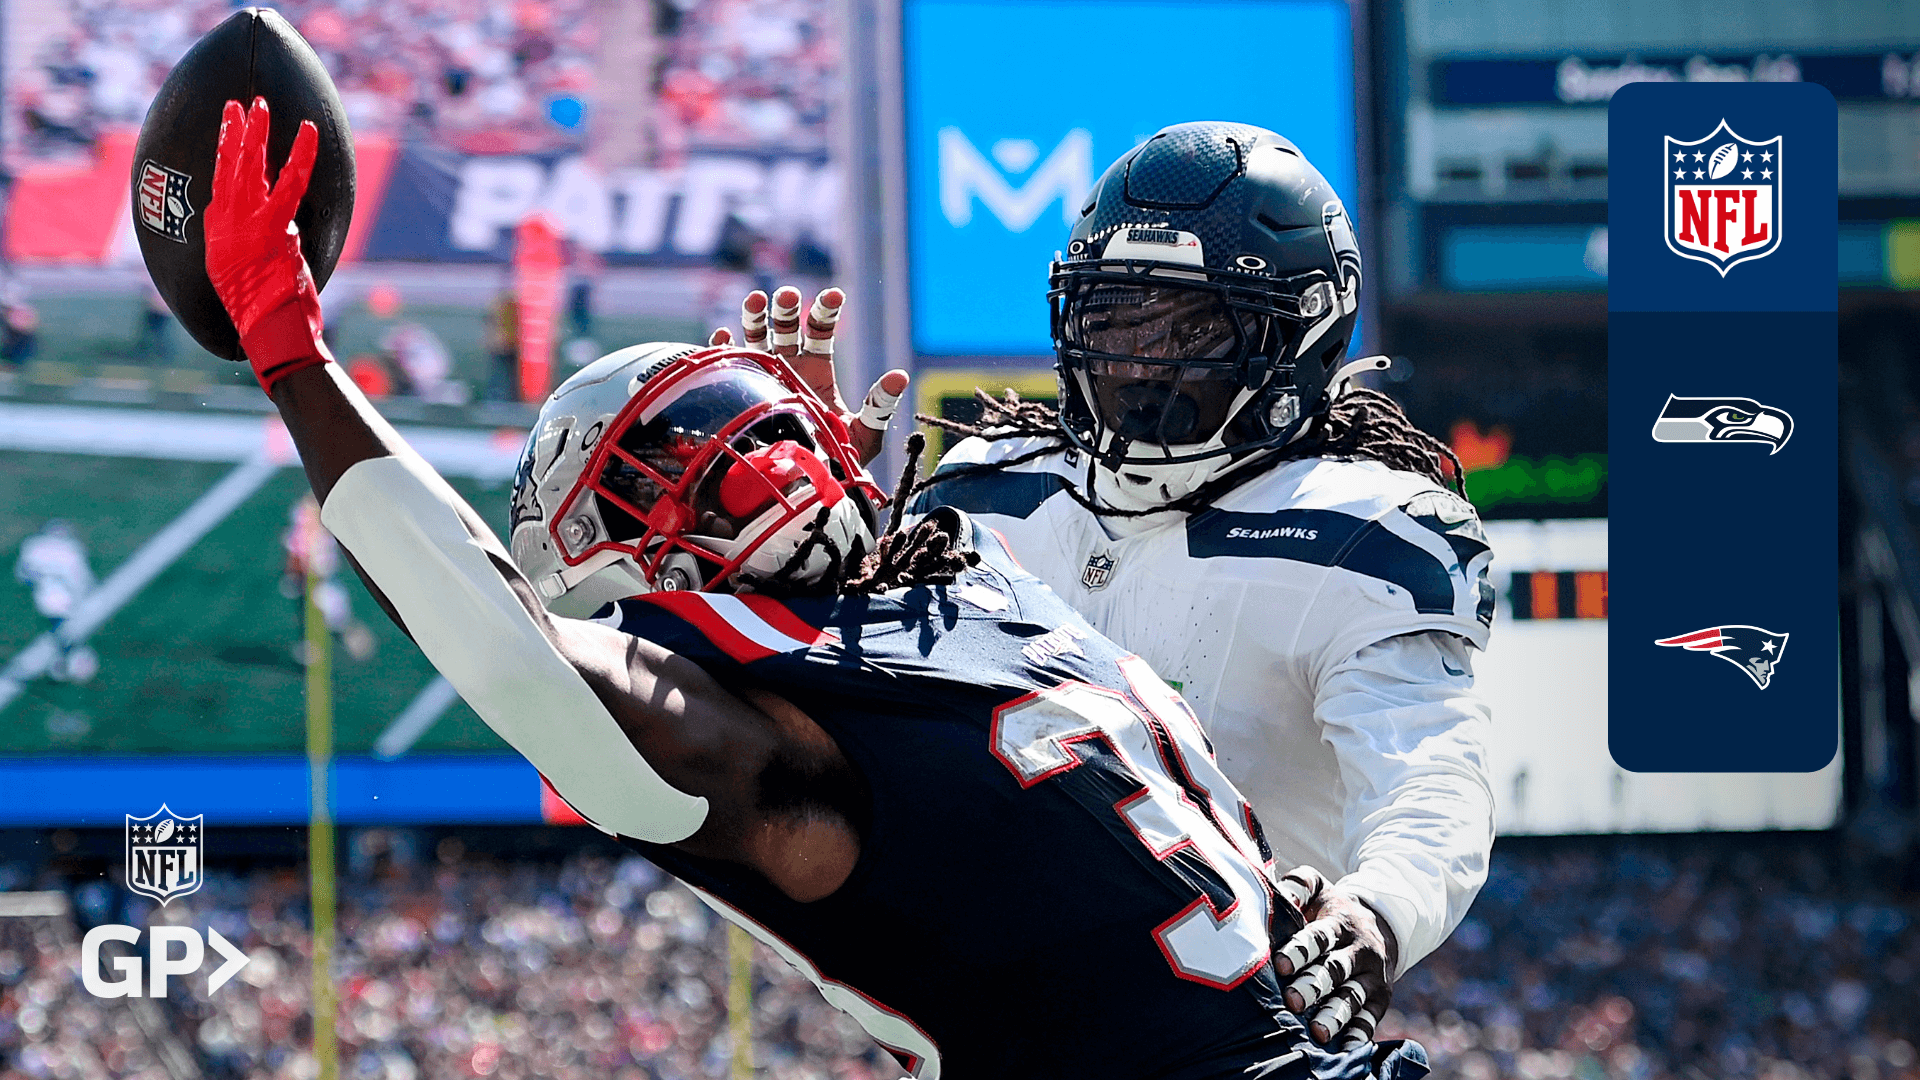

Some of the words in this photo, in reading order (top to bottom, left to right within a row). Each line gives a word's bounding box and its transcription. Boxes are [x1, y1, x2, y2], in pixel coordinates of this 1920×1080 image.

[142, 167, 166, 221] NFL
[1126, 229, 1179, 245] SEAHAWKS
[1226, 527, 1318, 540] SEAHAWKS
[1084, 567, 1105, 585] NFL
